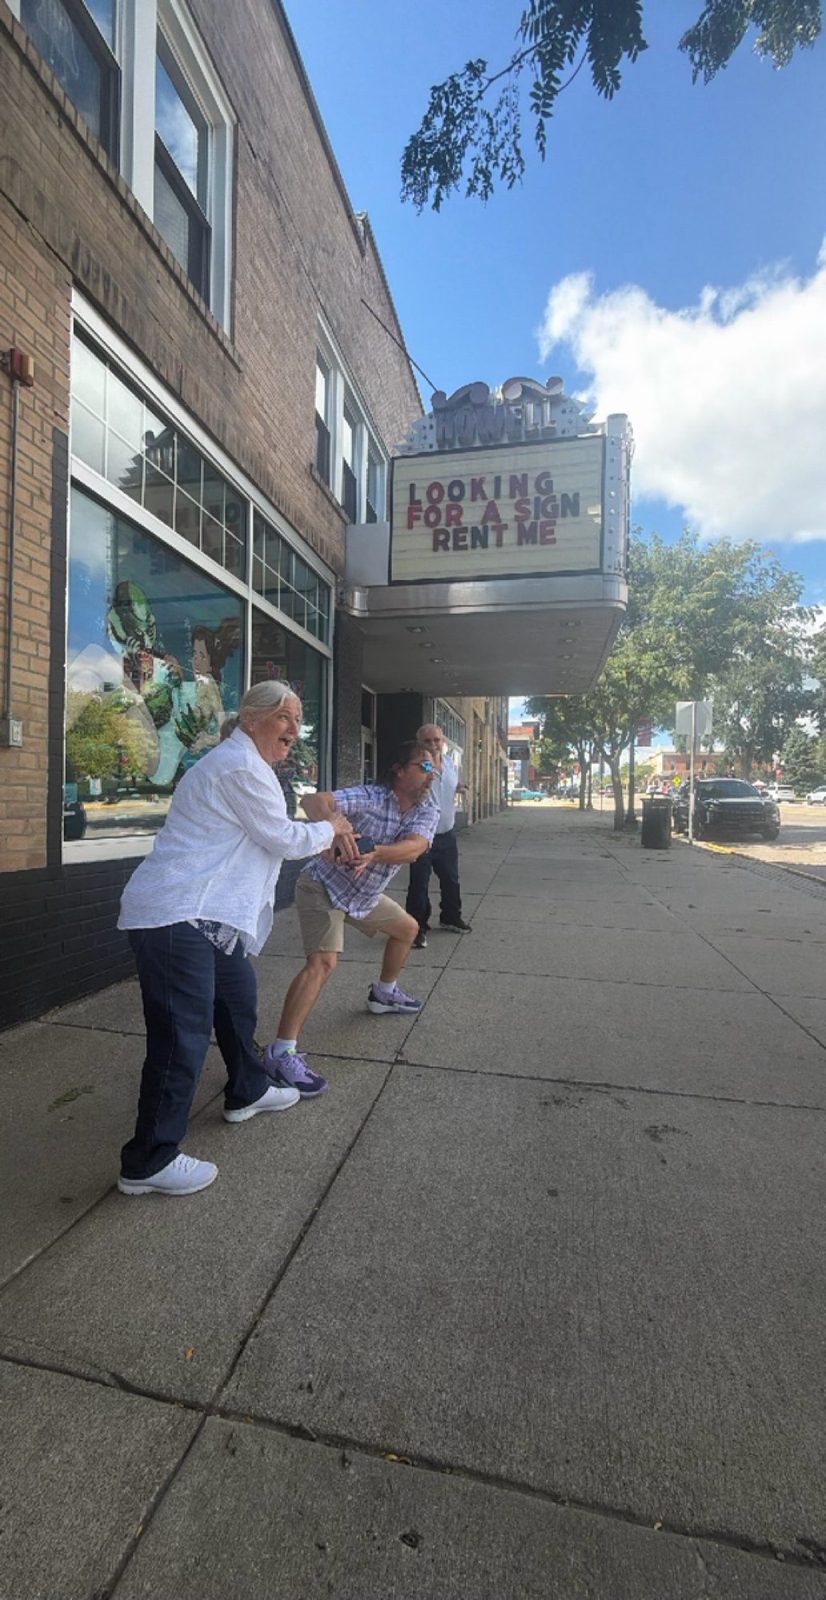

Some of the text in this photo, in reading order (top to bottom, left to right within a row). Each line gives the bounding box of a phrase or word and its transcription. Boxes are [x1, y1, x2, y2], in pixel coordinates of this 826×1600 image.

[436, 400, 557, 449] HOWELL
[409, 471, 554, 505] LOOKING
[407, 492, 580, 529] FOR A SIGN
[432, 520, 557, 552] RENT ME
